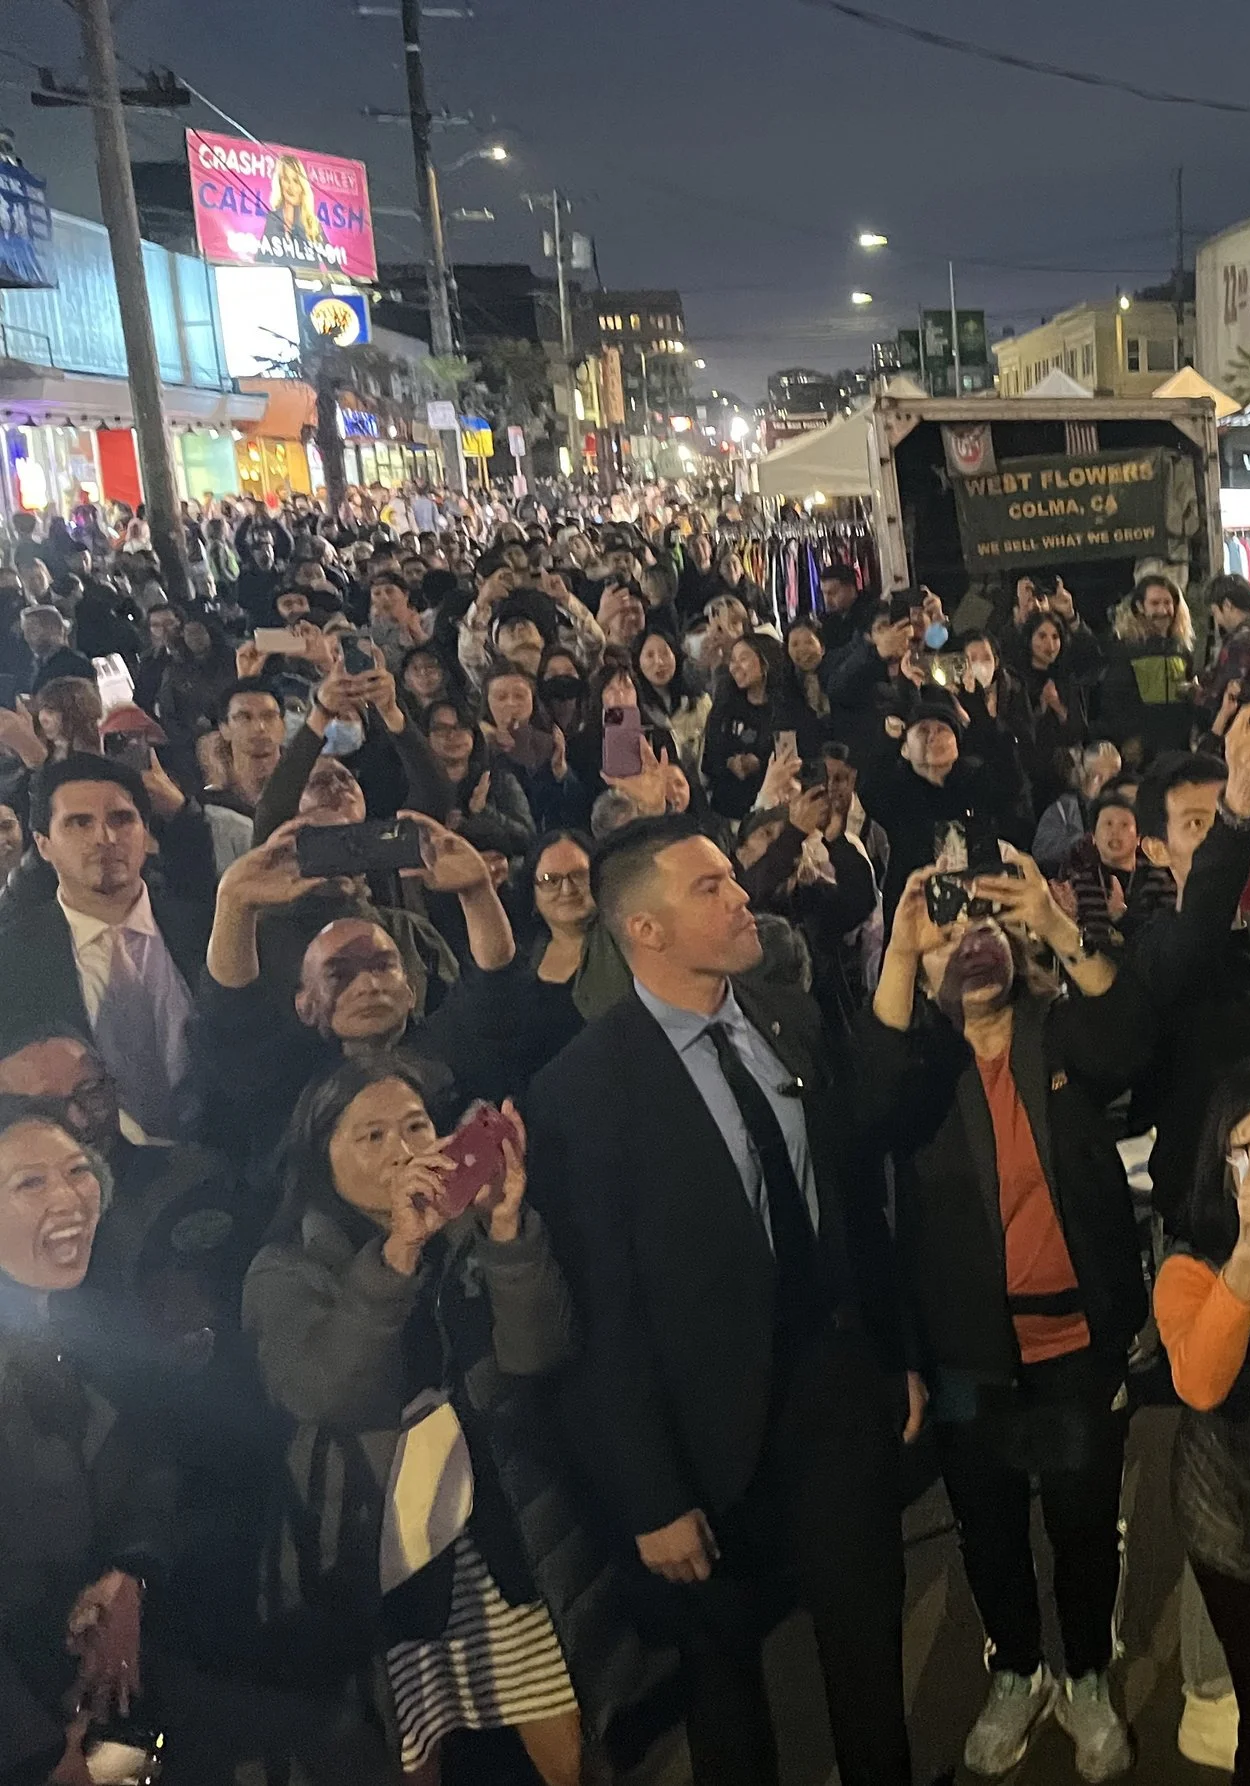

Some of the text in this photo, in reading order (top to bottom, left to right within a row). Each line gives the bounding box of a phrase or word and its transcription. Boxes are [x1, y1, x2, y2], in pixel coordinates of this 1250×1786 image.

[199, 144, 275, 179] CRASH?
[310, 166, 358, 189] ASHLEY
[199, 181, 364, 234] CALL ASH
[1040, 460, 1155, 490] FLOWERS
[1008, 498, 1085, 521] COLMA,
[1042, 533, 1083, 550] WHAT
[1087, 529, 1110, 545] WE
[1114, 525, 1156, 542] GROW
